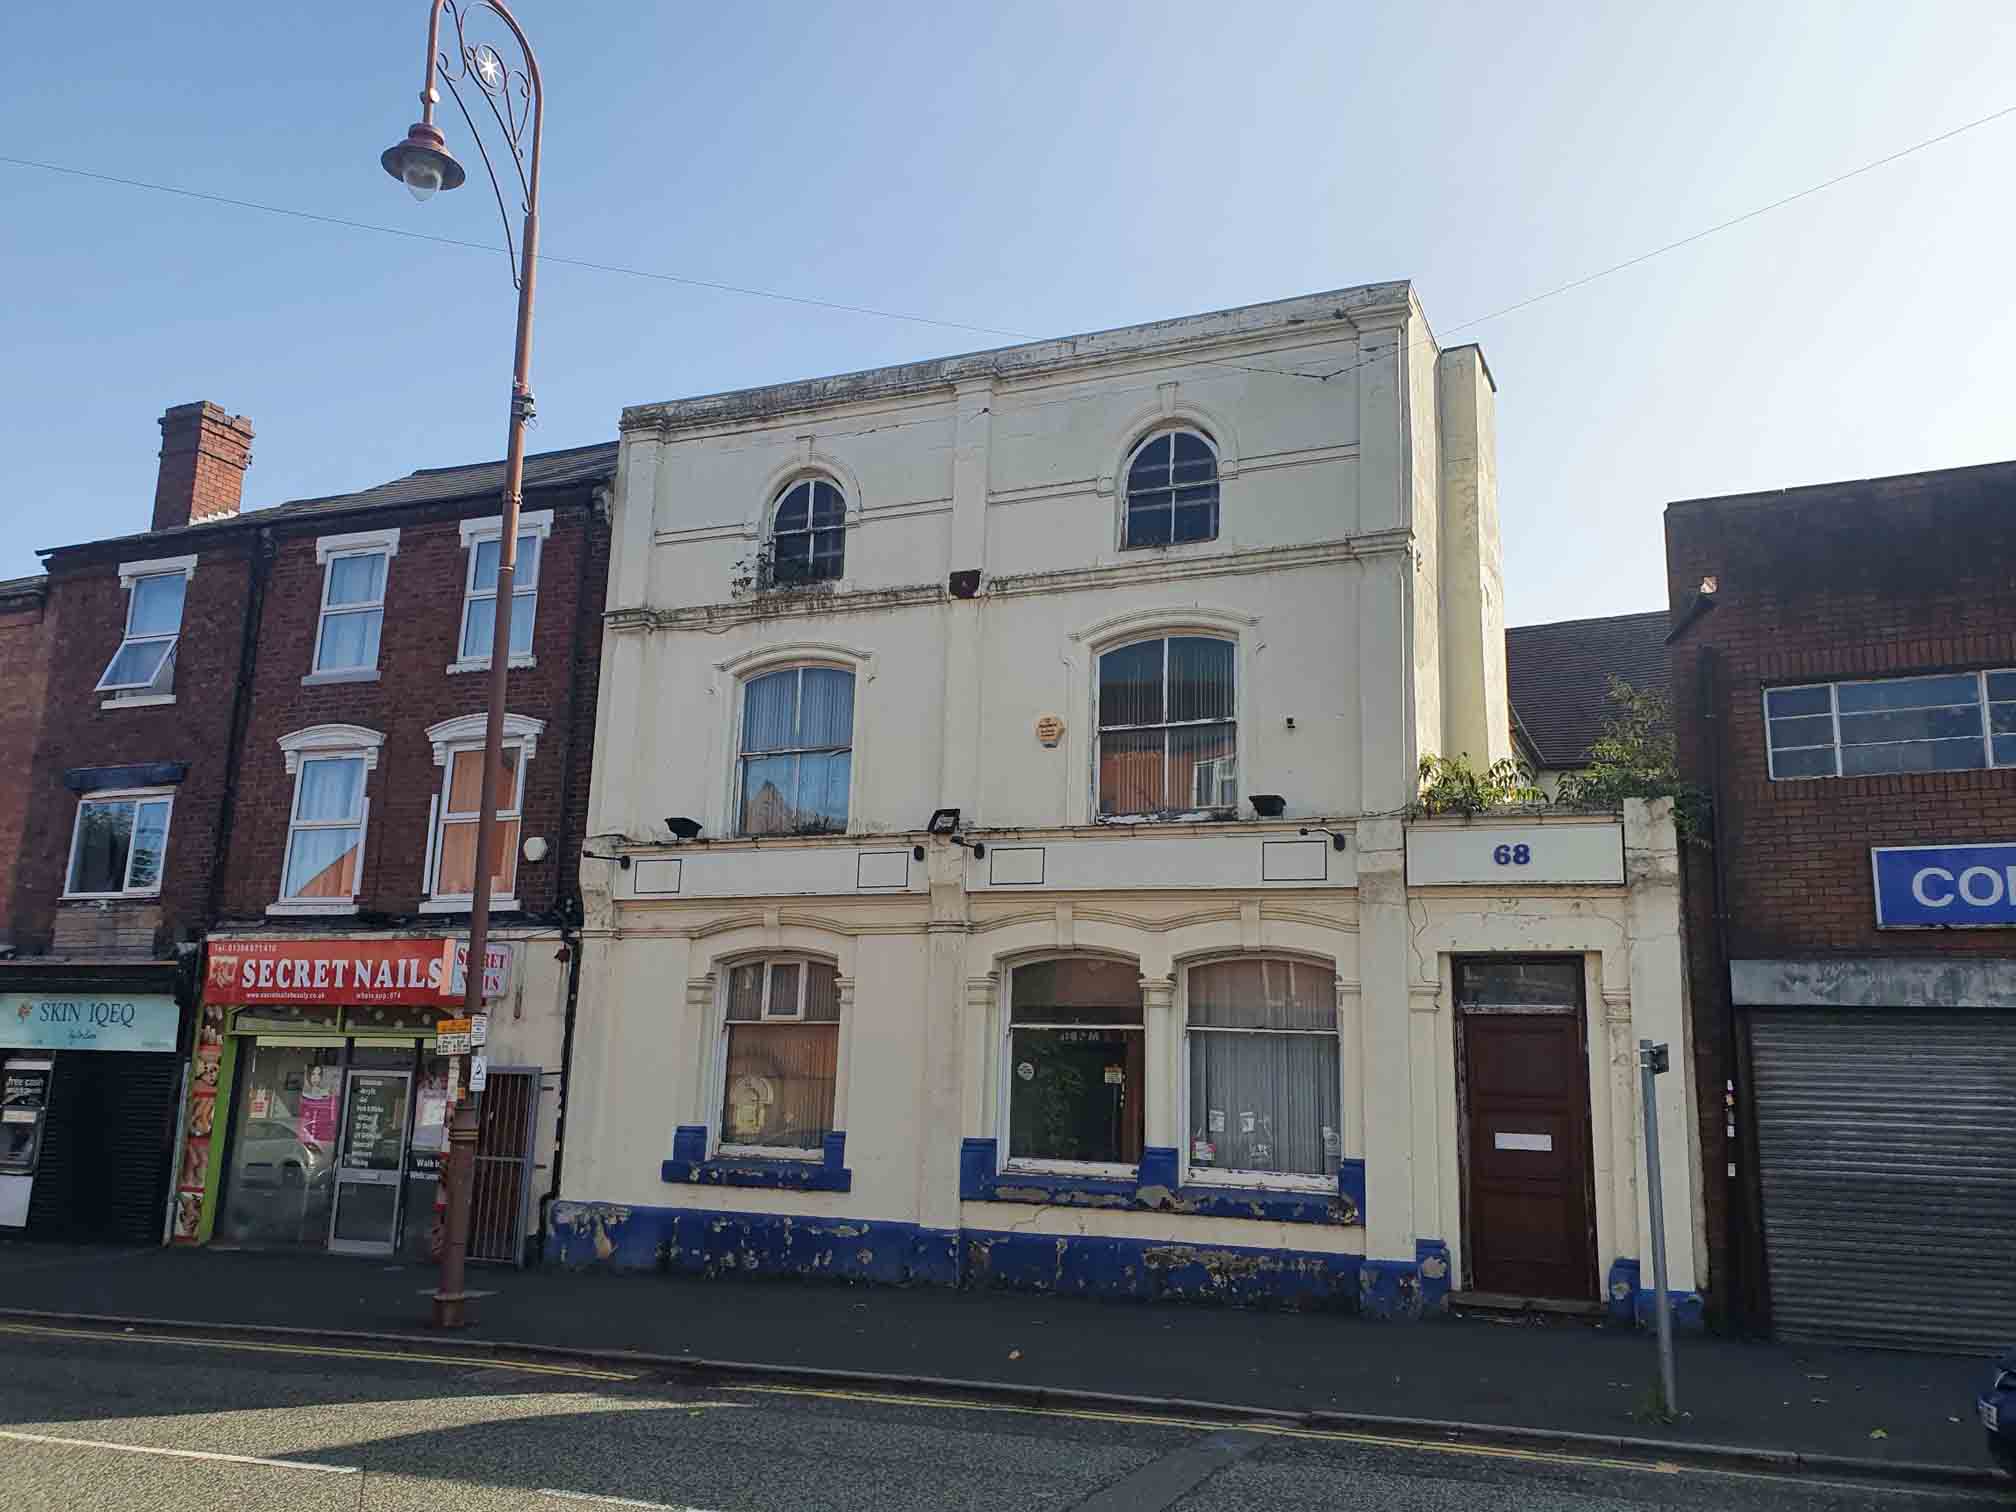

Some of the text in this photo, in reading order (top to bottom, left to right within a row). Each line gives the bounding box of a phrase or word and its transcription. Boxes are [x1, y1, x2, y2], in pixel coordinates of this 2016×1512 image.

[1493, 844, 1530, 865] 68
[241, 957, 442, 990] SECRET NAILS
[40, 1001, 136, 1029] SKIN IQEQ
[416, 1159, 435, 1168] Walk
